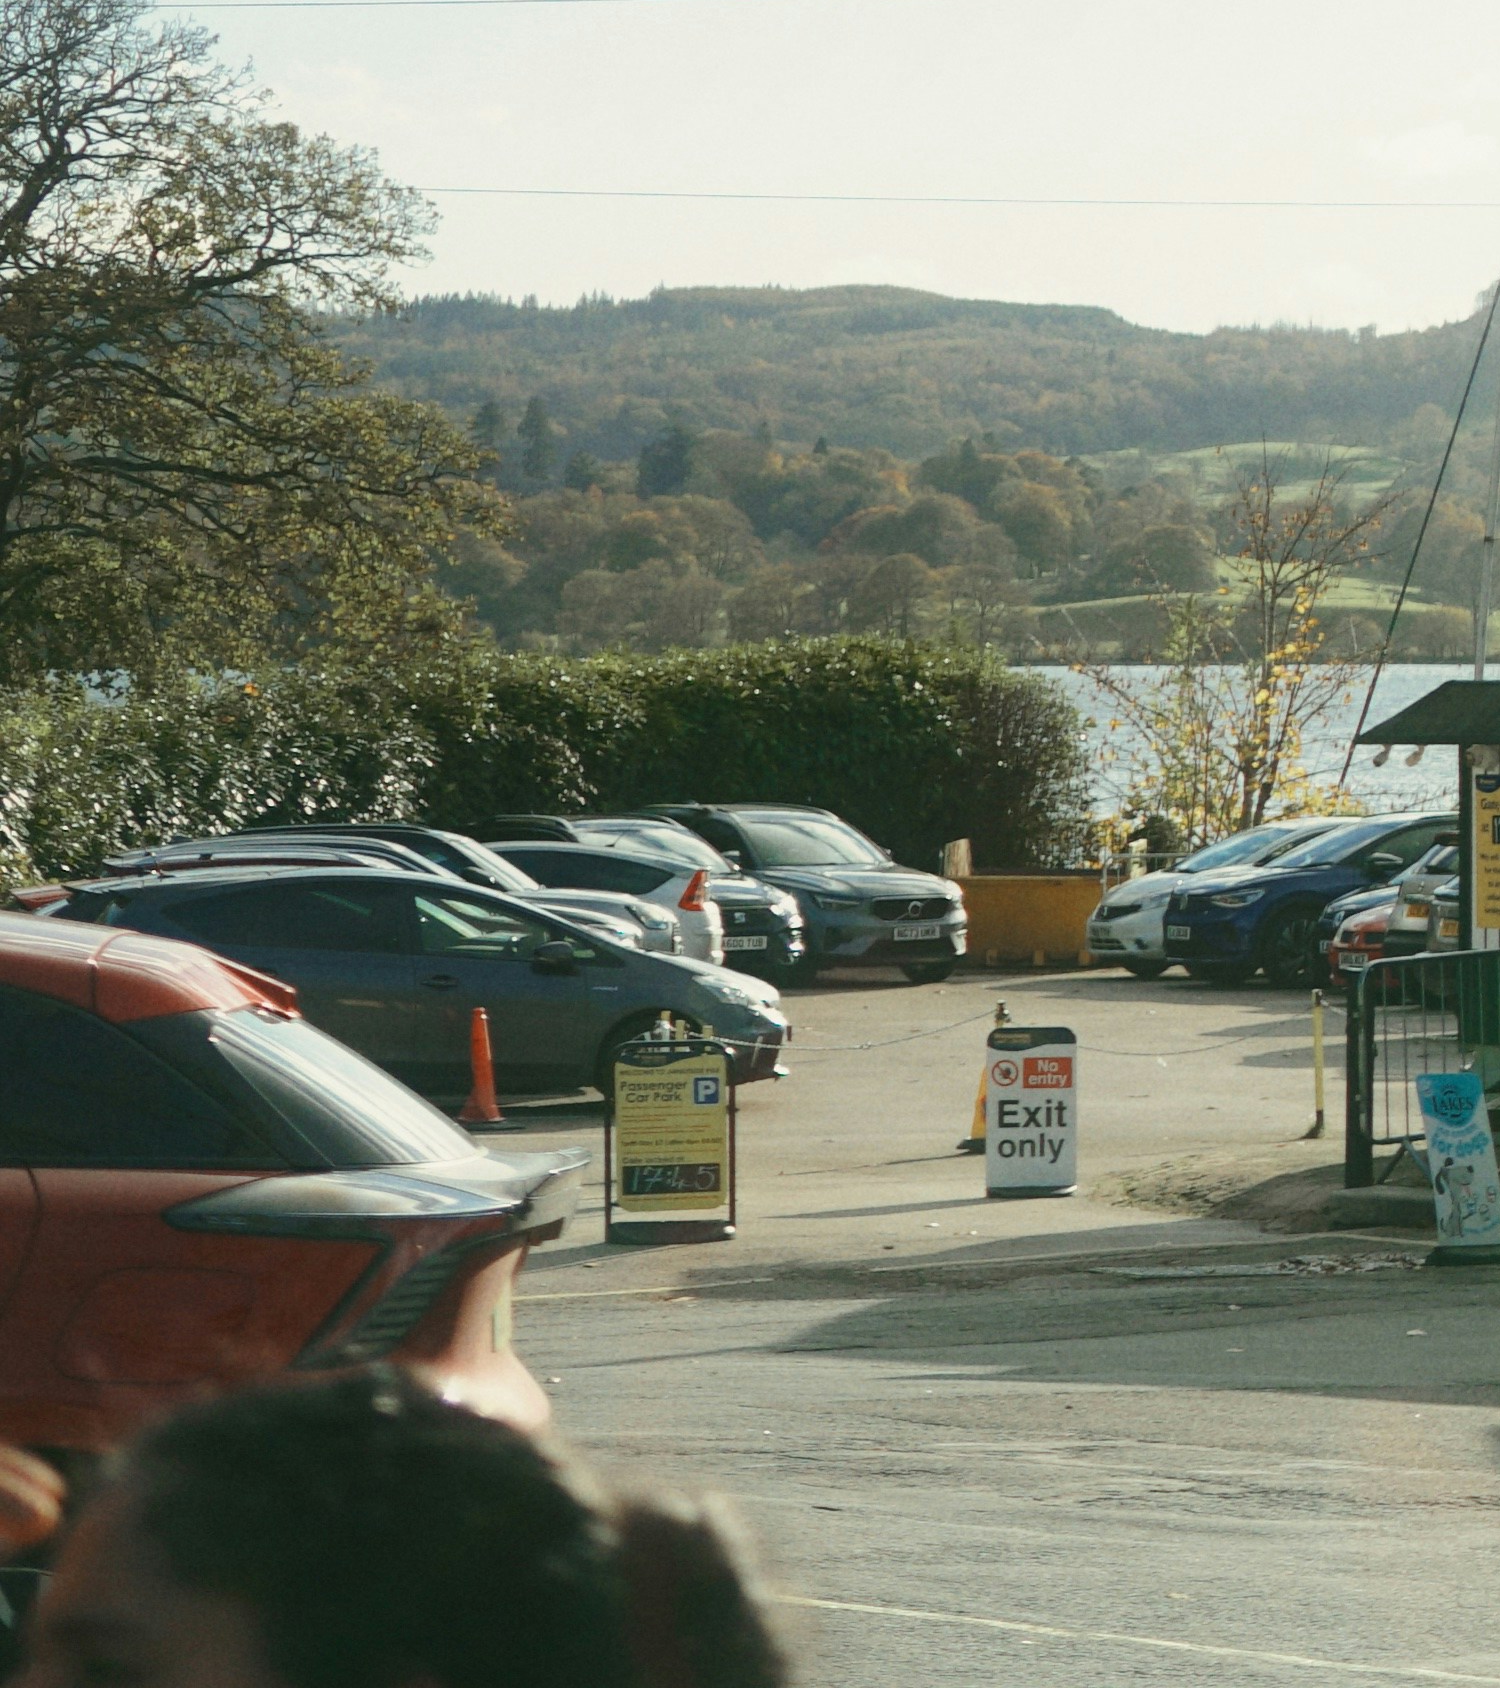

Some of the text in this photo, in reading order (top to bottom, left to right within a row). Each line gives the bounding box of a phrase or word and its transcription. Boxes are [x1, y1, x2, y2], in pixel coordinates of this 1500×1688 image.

[1037, 1059, 1059, 1072] No
[620, 1080, 687, 1094] Passenger
[1028, 1073, 1067, 1087] entry
[625, 1091, 682, 1104] Car Park
[698, 1080, 717, 1102] P
[997, 1099, 1067, 1128] Exit
[998, 1133, 1065, 1164] only
